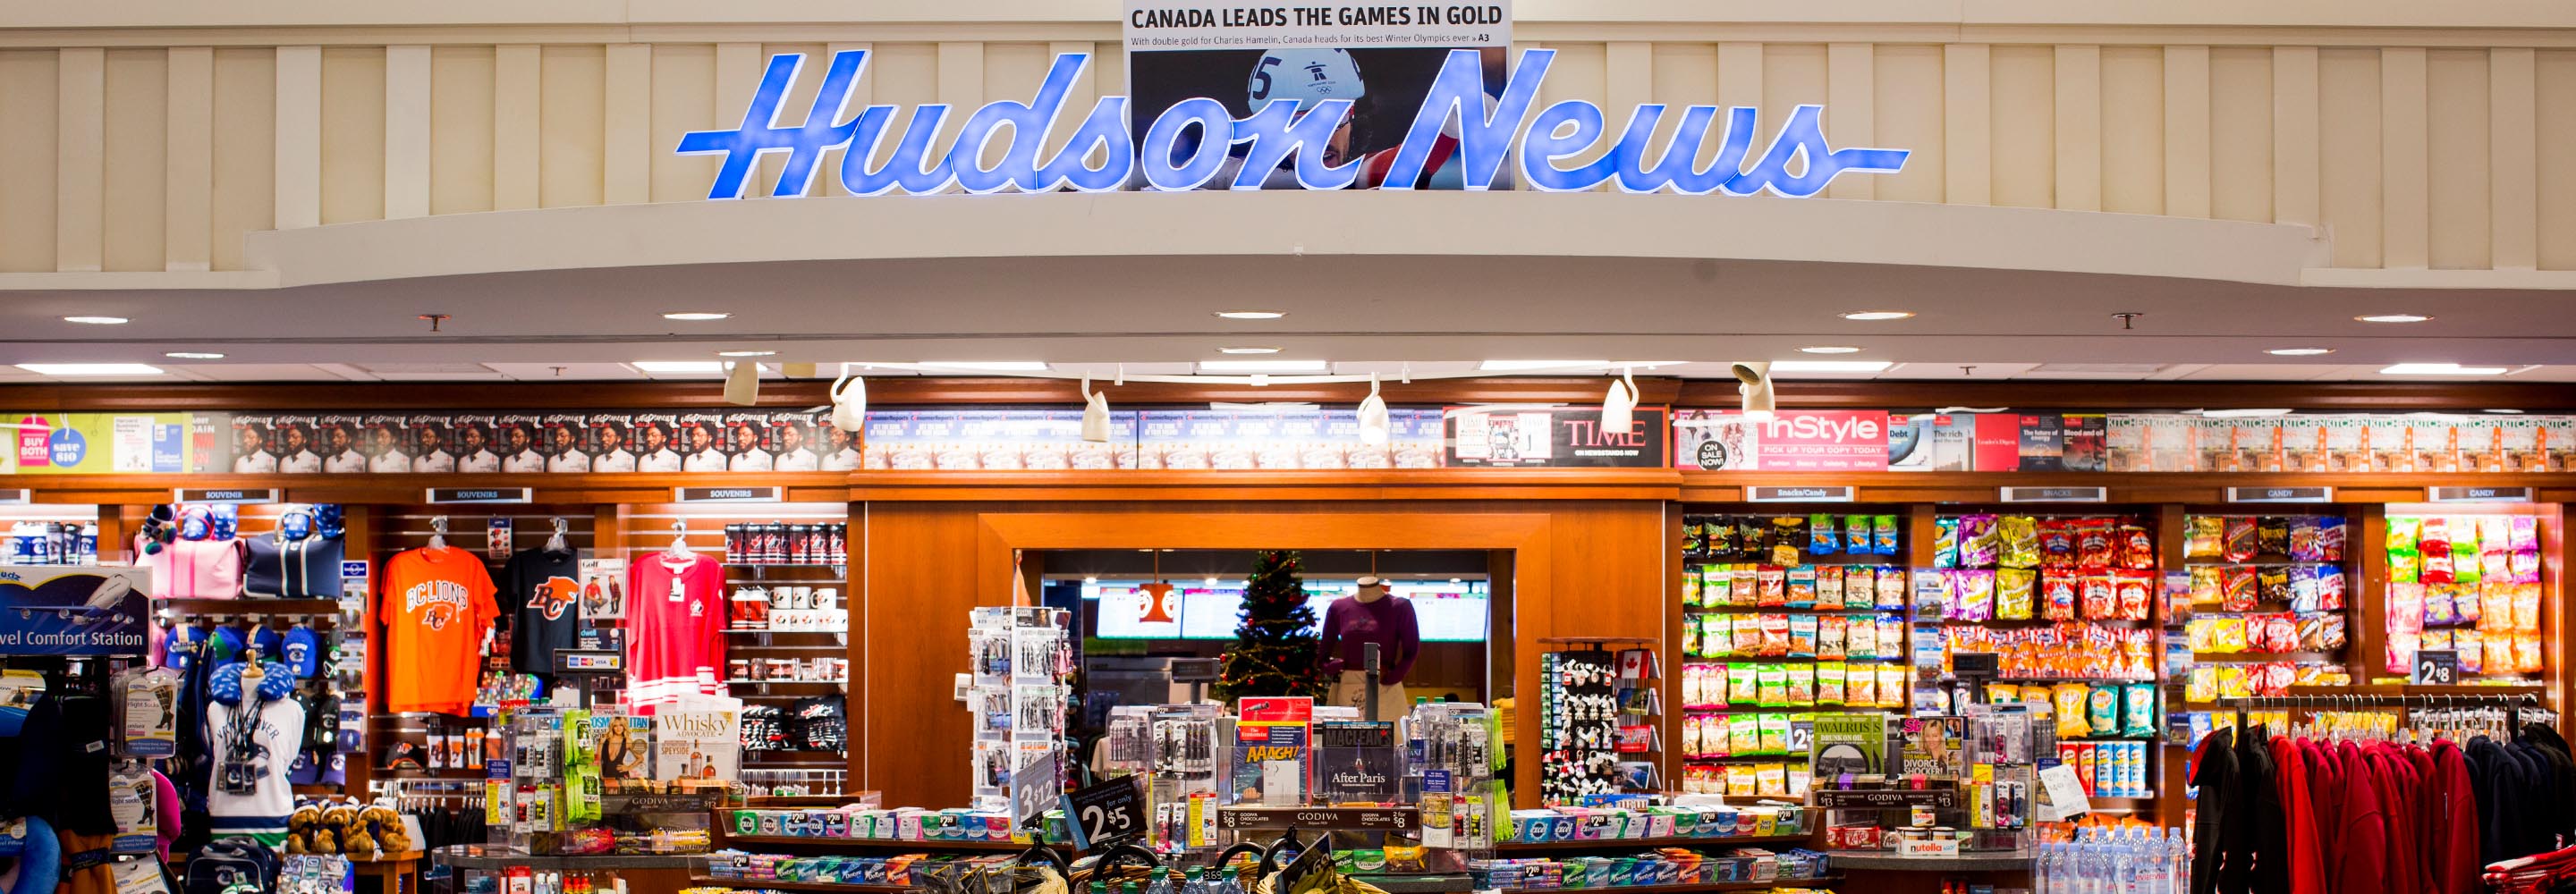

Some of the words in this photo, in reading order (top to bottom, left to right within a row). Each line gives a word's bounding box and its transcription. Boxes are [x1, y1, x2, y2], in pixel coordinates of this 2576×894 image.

[1131, 9, 1216, 29] CANADA
[1223, 7, 1287, 27] LEADS
[1293, 7, 1332, 26] THE
[1338, 6, 1411, 26] GAMES
[1418, 6, 1439, 25] IN
[1446, 5, 1503, 25] GOLD
[1131, 37, 1149, 46] With
[1152, 37, 1180, 46] double
[1182, 37, 1199, 46] gold
[1200, 36, 1211, 45] for
[1214, 36, 1243, 45] Charles
[1246, 36, 1281, 46] Hamelin,
[1283, 35, 1312, 44] Canada
[1315, 35, 1338, 44] heads
[1341, 34, 1351, 43] for
[1354, 34, 1364, 43] its
[1367, 34, 1383, 43] best
[1385, 34, 1411, 43] Winter
[1413, 34, 1450, 44] Olympics
[1478, 34, 1489, 42] A3
[675, 48, 1366, 199] Hudson
[1379, 47, 1911, 198] News
[1767, 415, 1878, 443] InStyle
[1889, 430, 1908, 438] Debt
[1934, 430, 1947, 438] The
[1948, 430, 1962, 438] rich
[24, 437, 44, 447] BUY
[1705, 443, 1718, 451] ON
[21, 447, 47, 457] BOTH
[1701, 451, 1723, 459] SALE
[1701, 458, 1724, 467] NOW!
[456, 490, 498, 499] SOUVENIRS
[710, 490, 752, 498] SOUVENIRS
[1778, 488, 1826, 498] Snacks/Candy
[2268, 490, 2293, 498] CANDY
[2469, 489, 2496, 497] CANDY
[27, 629, 87, 645] Comfort
[91, 631, 143, 645] Station
[2420, 661, 2436, 685] 2
[2436, 667, 2450, 682] $8
[664, 713, 730, 737] Whisky
[1819, 722, 1870, 733] WALRUS
[661, 746, 690, 755] SPEYSIDE
[1245, 745, 1301, 763] AAAGH!
[1903, 760, 1938, 768] DIVORCE
[1332, 772, 1359, 783] After
[1360, 772, 1385, 783] Paris
[631, 797, 669, 805] GODIVA
[1020, 784, 1034, 822] 3
[1034, 780, 1054, 805] $12
[1107, 800, 1116, 810] for
[1118, 795, 1132, 805] only
[1821, 797, 1833, 806] $13
[1938, 797, 1951, 806] $13
[1297, 813, 1339, 821] GODIVA
[1082, 805, 1113, 845] 2
[1107, 806, 1131, 830] $5
[1224, 817, 1235, 828] $8
[1394, 817, 1405, 828] $8
[1530, 825, 1546, 834] excel
[1555, 824, 1572, 833] excel
[1911, 844, 1942, 852] nutella
[1567, 873, 1585, 884] Dentyne
[1637, 873, 1655, 882] Dentyne
